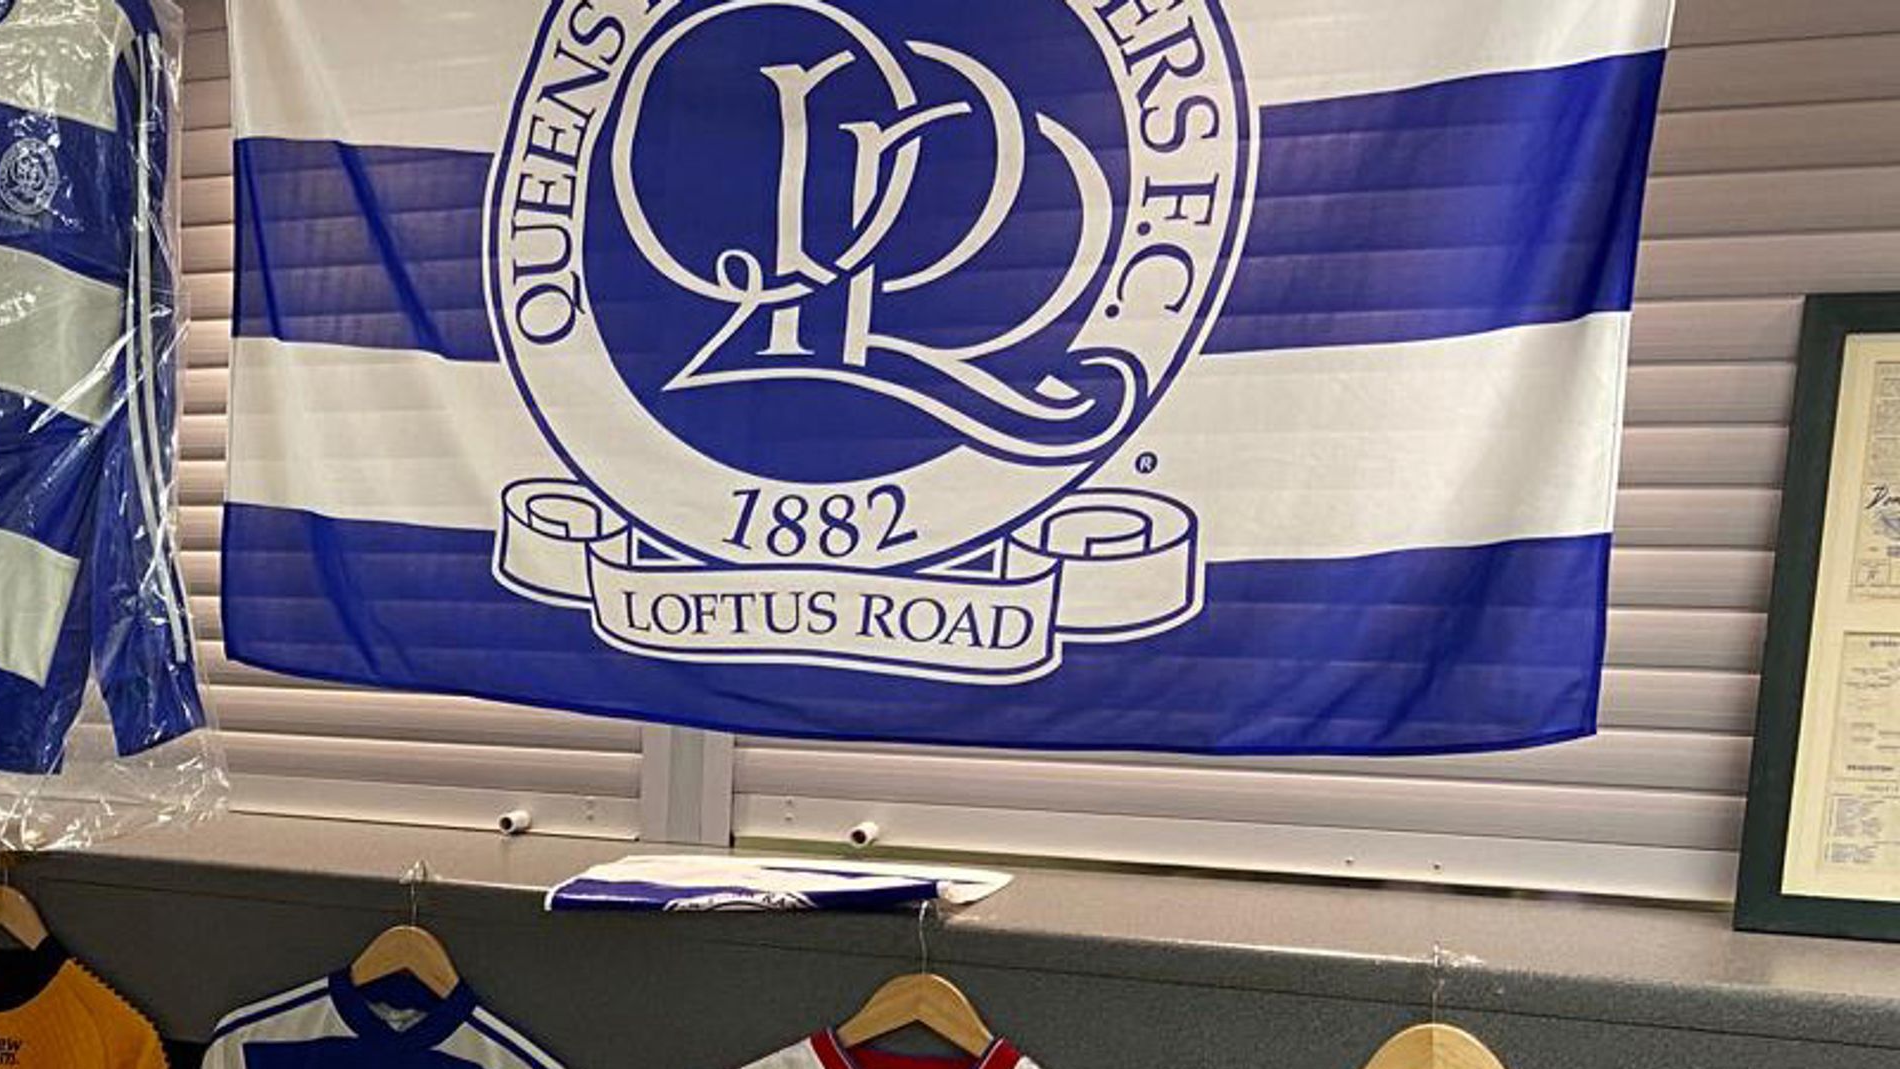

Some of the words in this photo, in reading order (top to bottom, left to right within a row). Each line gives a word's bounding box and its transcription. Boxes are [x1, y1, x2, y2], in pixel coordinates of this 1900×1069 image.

[511, 8, 627, 346] QUEENS
[722, 484, 919, 559] 1882
[622, 591, 838, 637] LOFTUS
[856, 595, 1036, 651] ROAD
